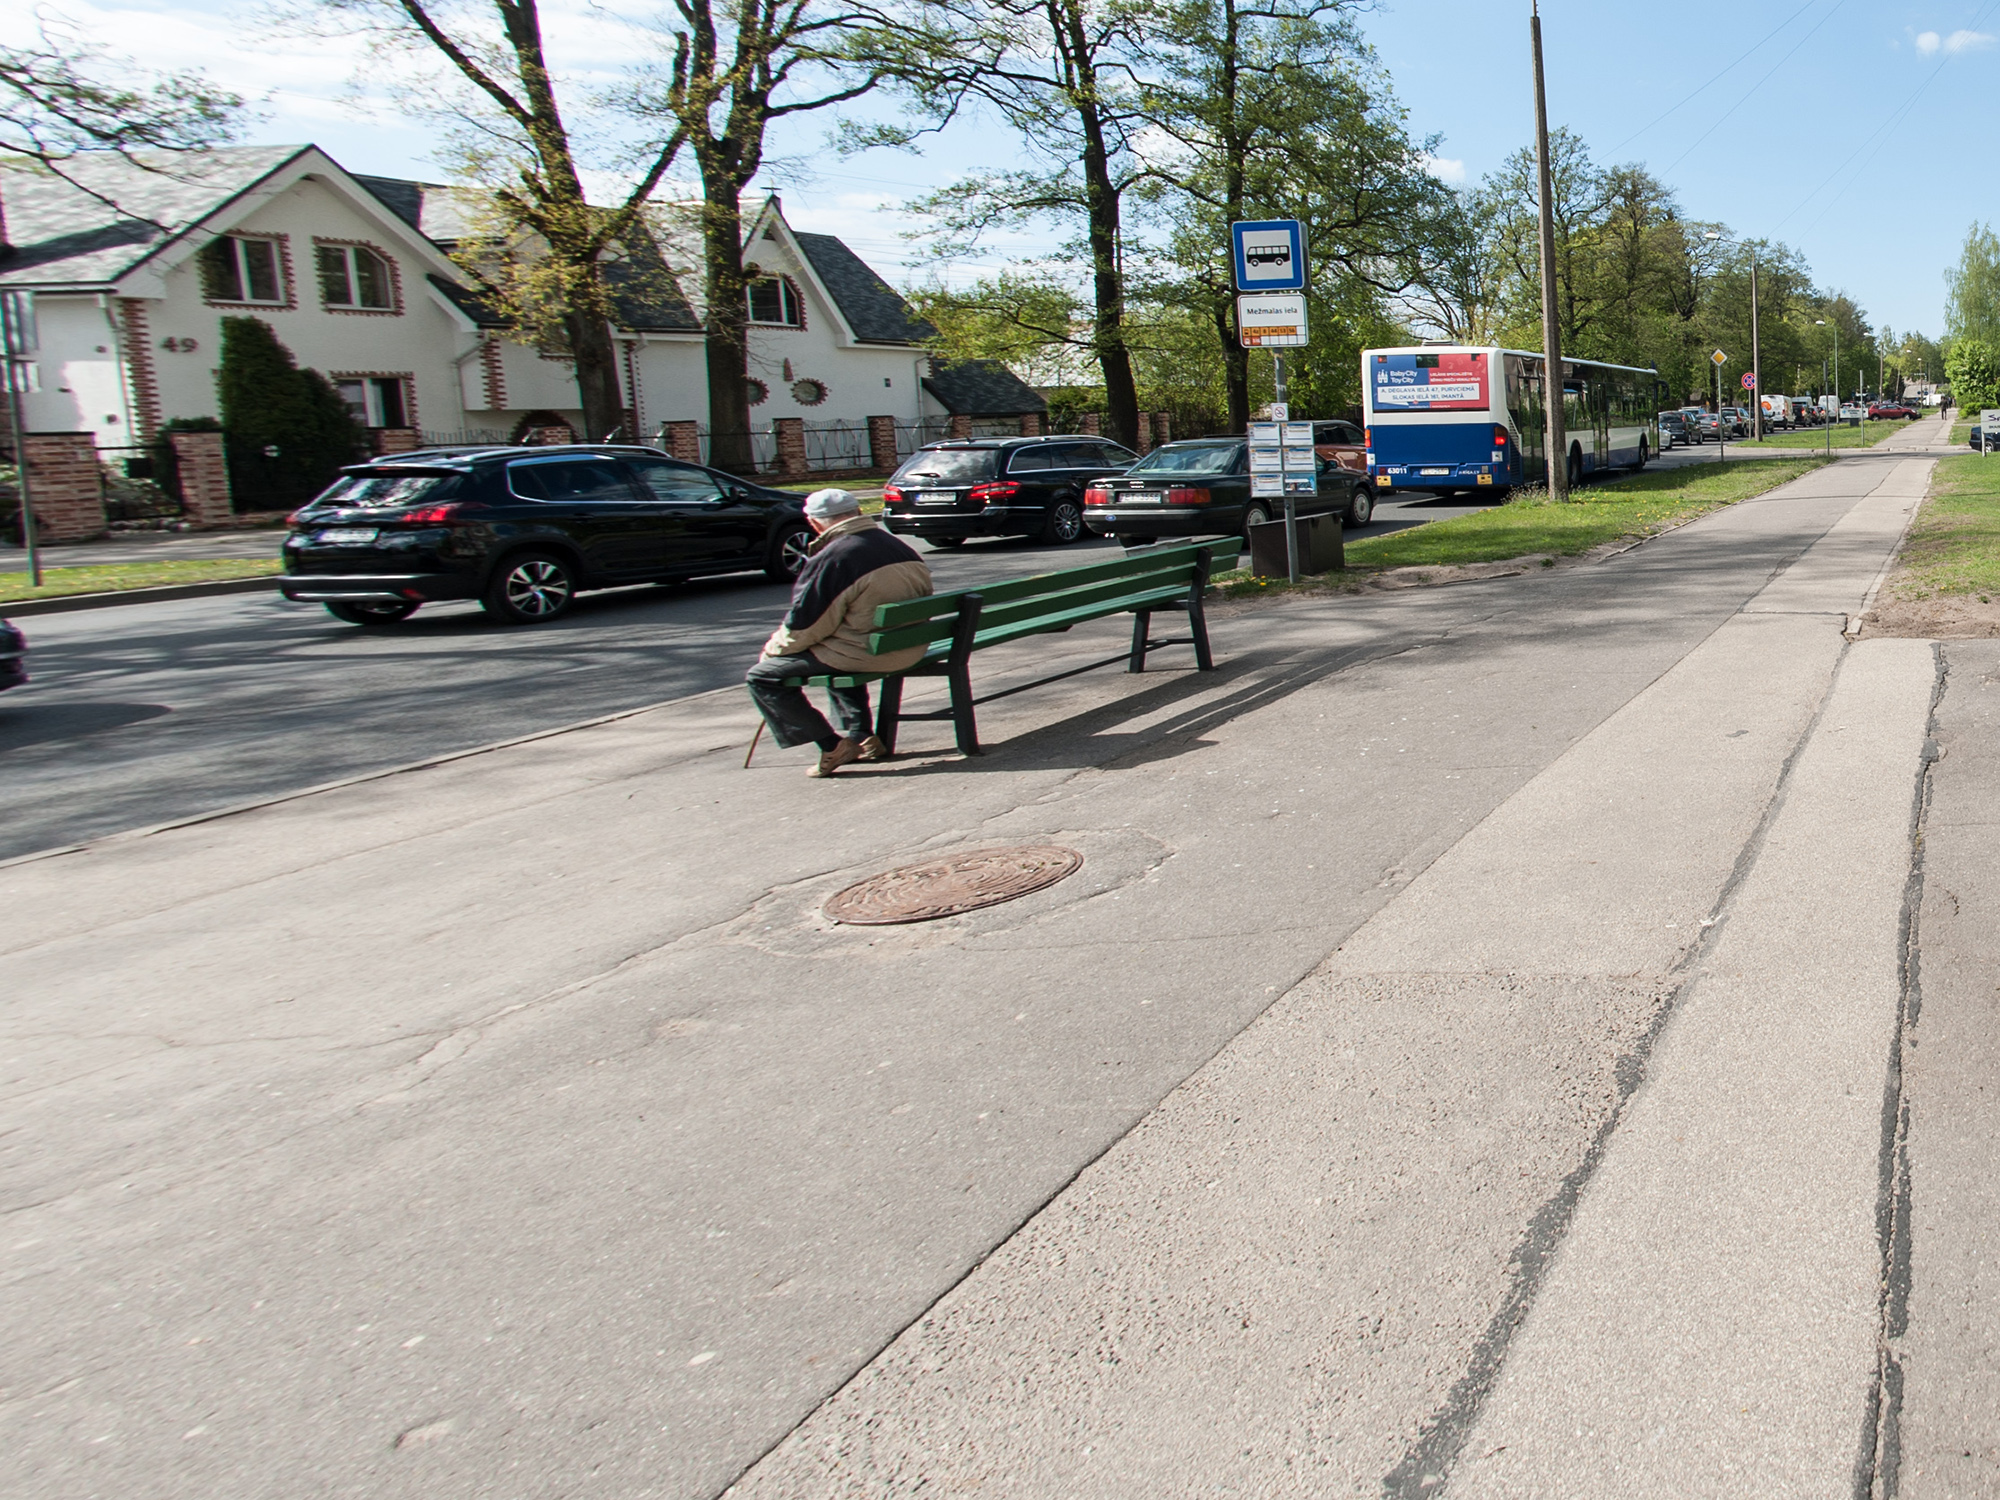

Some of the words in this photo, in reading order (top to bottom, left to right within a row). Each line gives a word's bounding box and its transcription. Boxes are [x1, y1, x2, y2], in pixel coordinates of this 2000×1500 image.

[1247, 307, 1283, 315] Mežmalas
[1285, 306, 1298, 314] iela
[161, 336, 199, 353] 49
